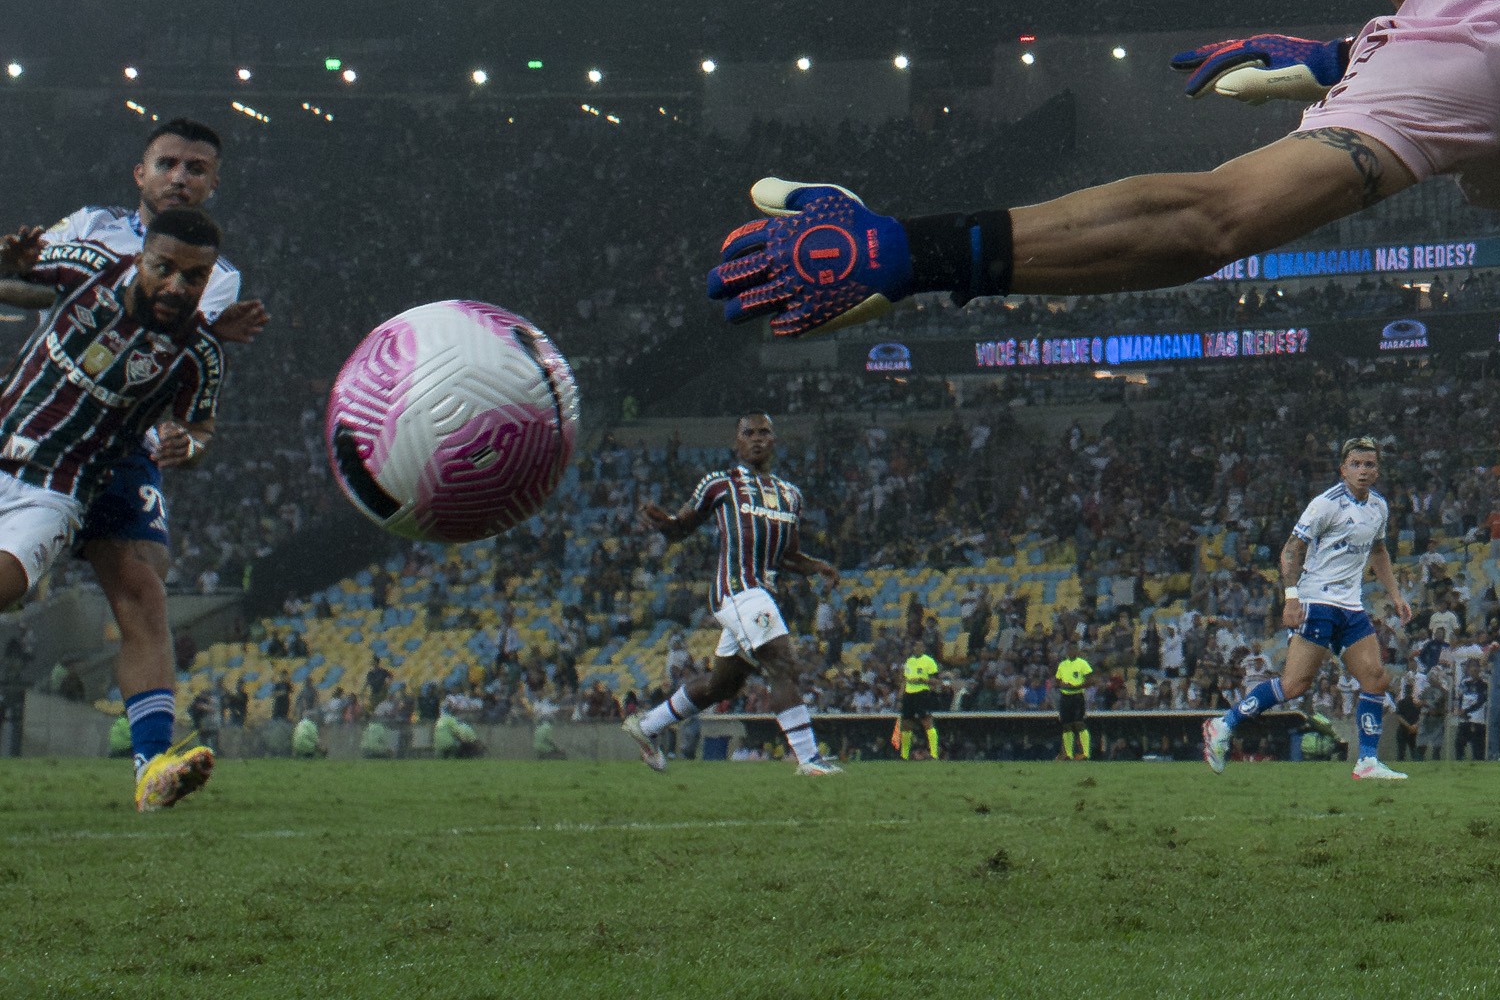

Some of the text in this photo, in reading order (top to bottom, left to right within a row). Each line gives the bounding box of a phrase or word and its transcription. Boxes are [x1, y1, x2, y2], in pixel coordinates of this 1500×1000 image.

[1375, 246, 1409, 271] NAS
[1413, 242, 1477, 269] REDES?
[1203, 331, 1239, 357] NAS
[1242, 328, 1310, 356] REDES?
